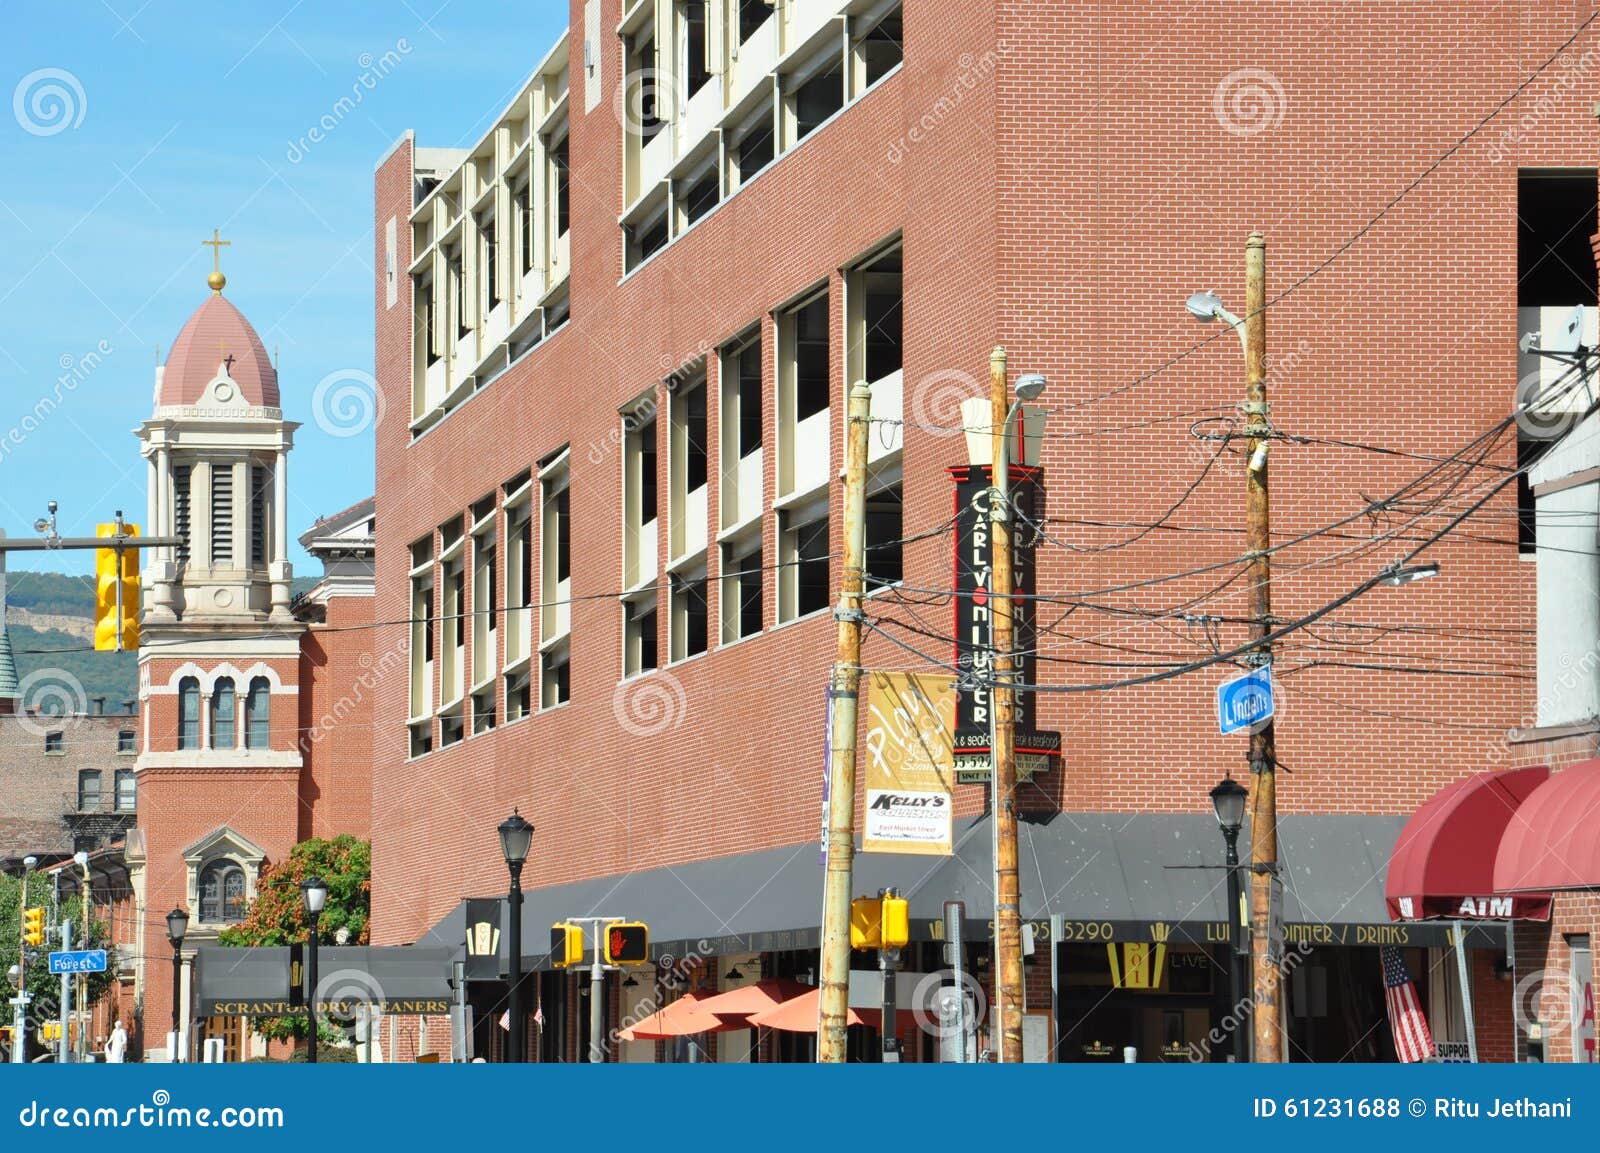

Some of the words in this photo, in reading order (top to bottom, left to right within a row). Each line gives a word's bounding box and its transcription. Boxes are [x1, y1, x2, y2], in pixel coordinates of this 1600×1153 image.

[870, 794, 945, 810] KELLY'S
[1459, 896, 1513, 917] ATM
[1064, 922, 1113, 940] 5290
[1356, 926, 1409, 944] DRINKS
[54, 958, 91, 970] Forest
[1170, 954, 1207, 969] LIVE
[316, 1002, 352, 1014] DRY
[1438, 1043, 1470, 1058] SUPPOR
